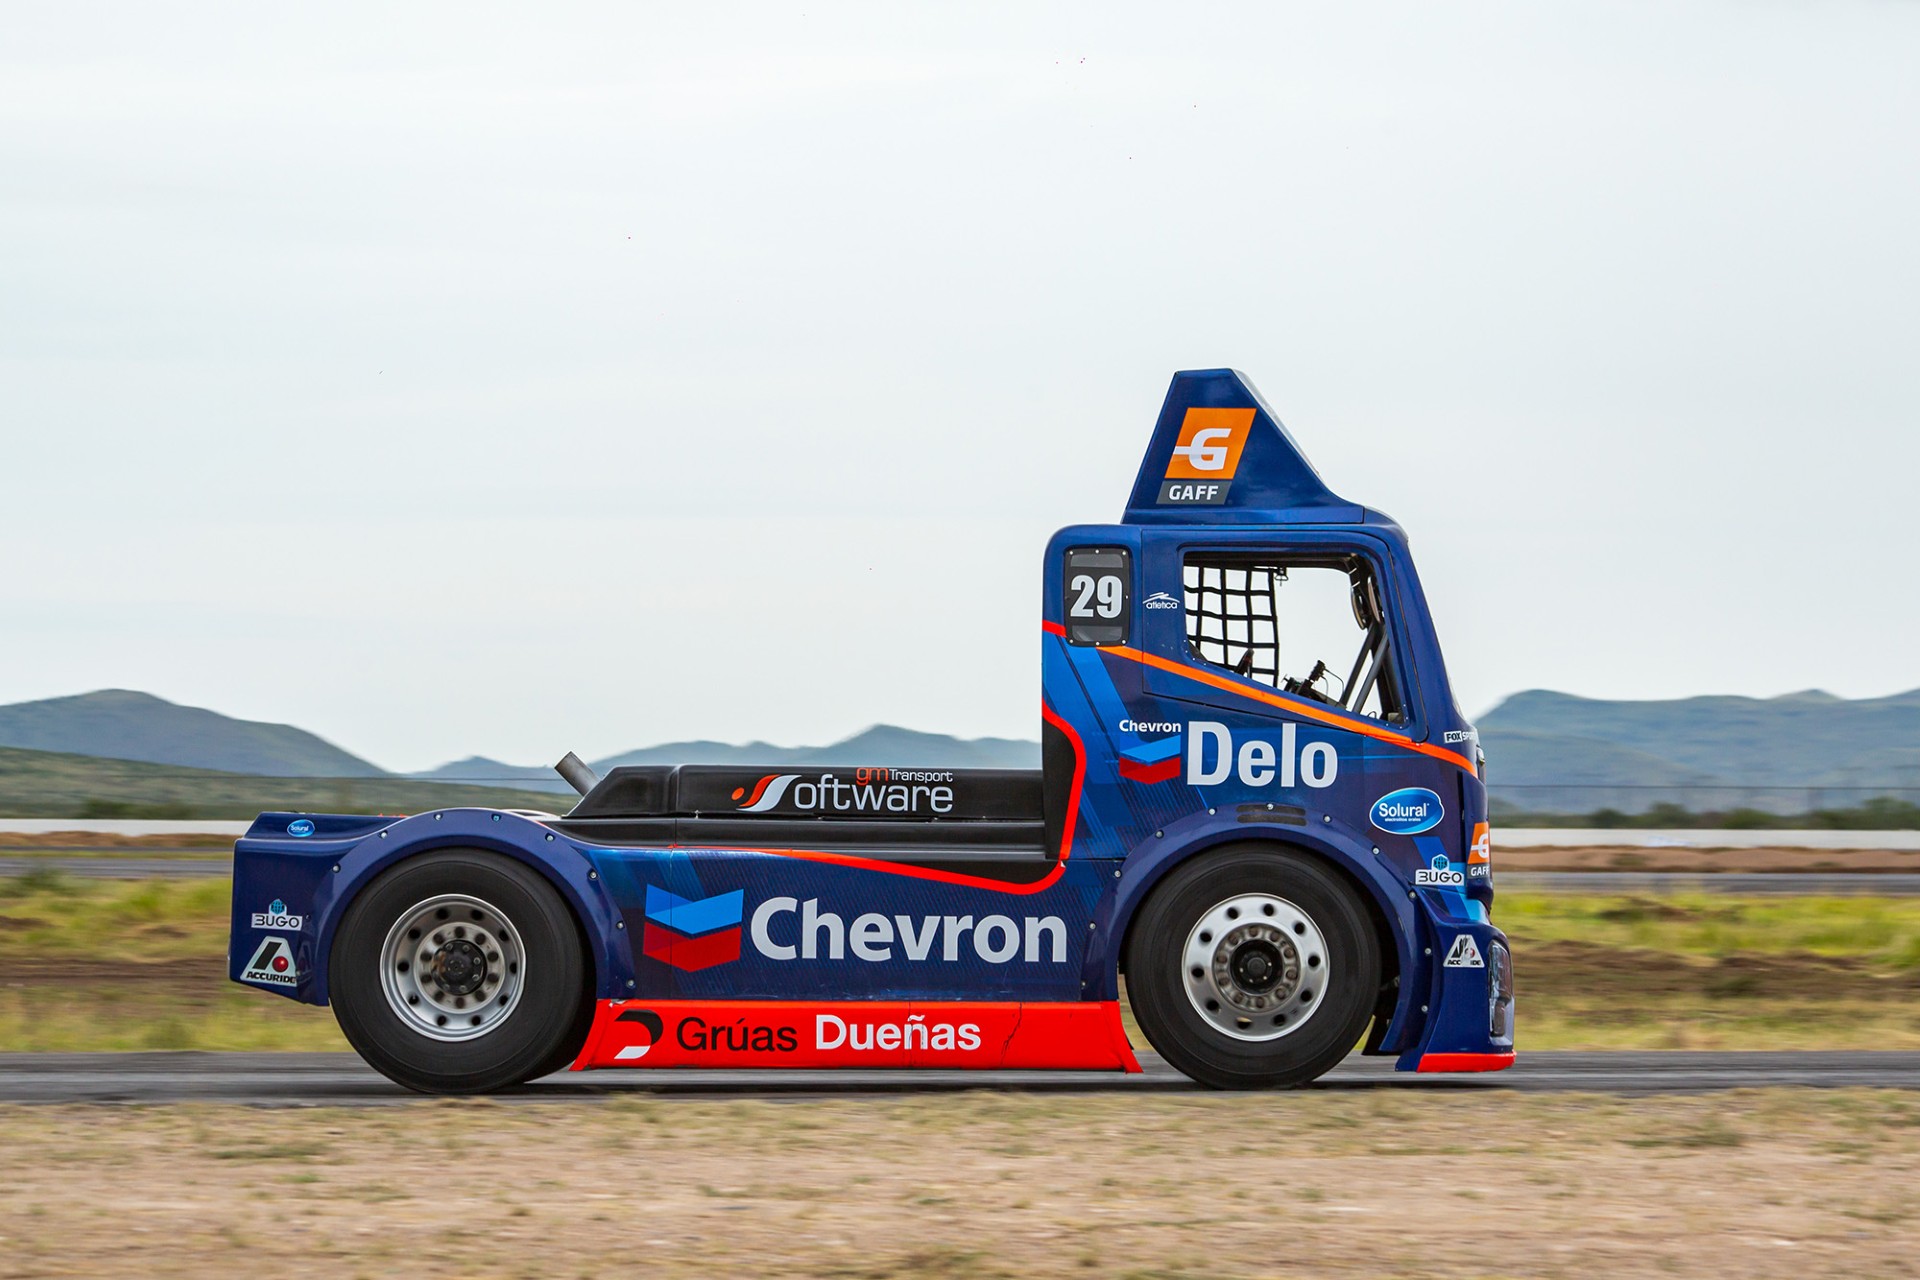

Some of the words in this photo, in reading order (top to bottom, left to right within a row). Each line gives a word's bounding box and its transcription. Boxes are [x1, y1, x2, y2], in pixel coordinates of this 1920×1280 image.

[1168, 485, 1219, 501] GAFF
[1070, 574, 1123, 619] 29
[1118, 719, 1182, 733] Chevron
[1446, 732, 1462, 742] FOX
[1187, 720, 1339, 788] Delo
[1378, 802, 1428, 817] Solural
[1418, 871, 1462, 883] BUGO
[254, 914, 300, 928] BUGO
[750, 896, 1069, 963] Chevron
[246, 970, 297, 984] ACCURIDE
[676, 1016, 798, 1052] Grúas
[815, 1013, 981, 1051] Dueñas
